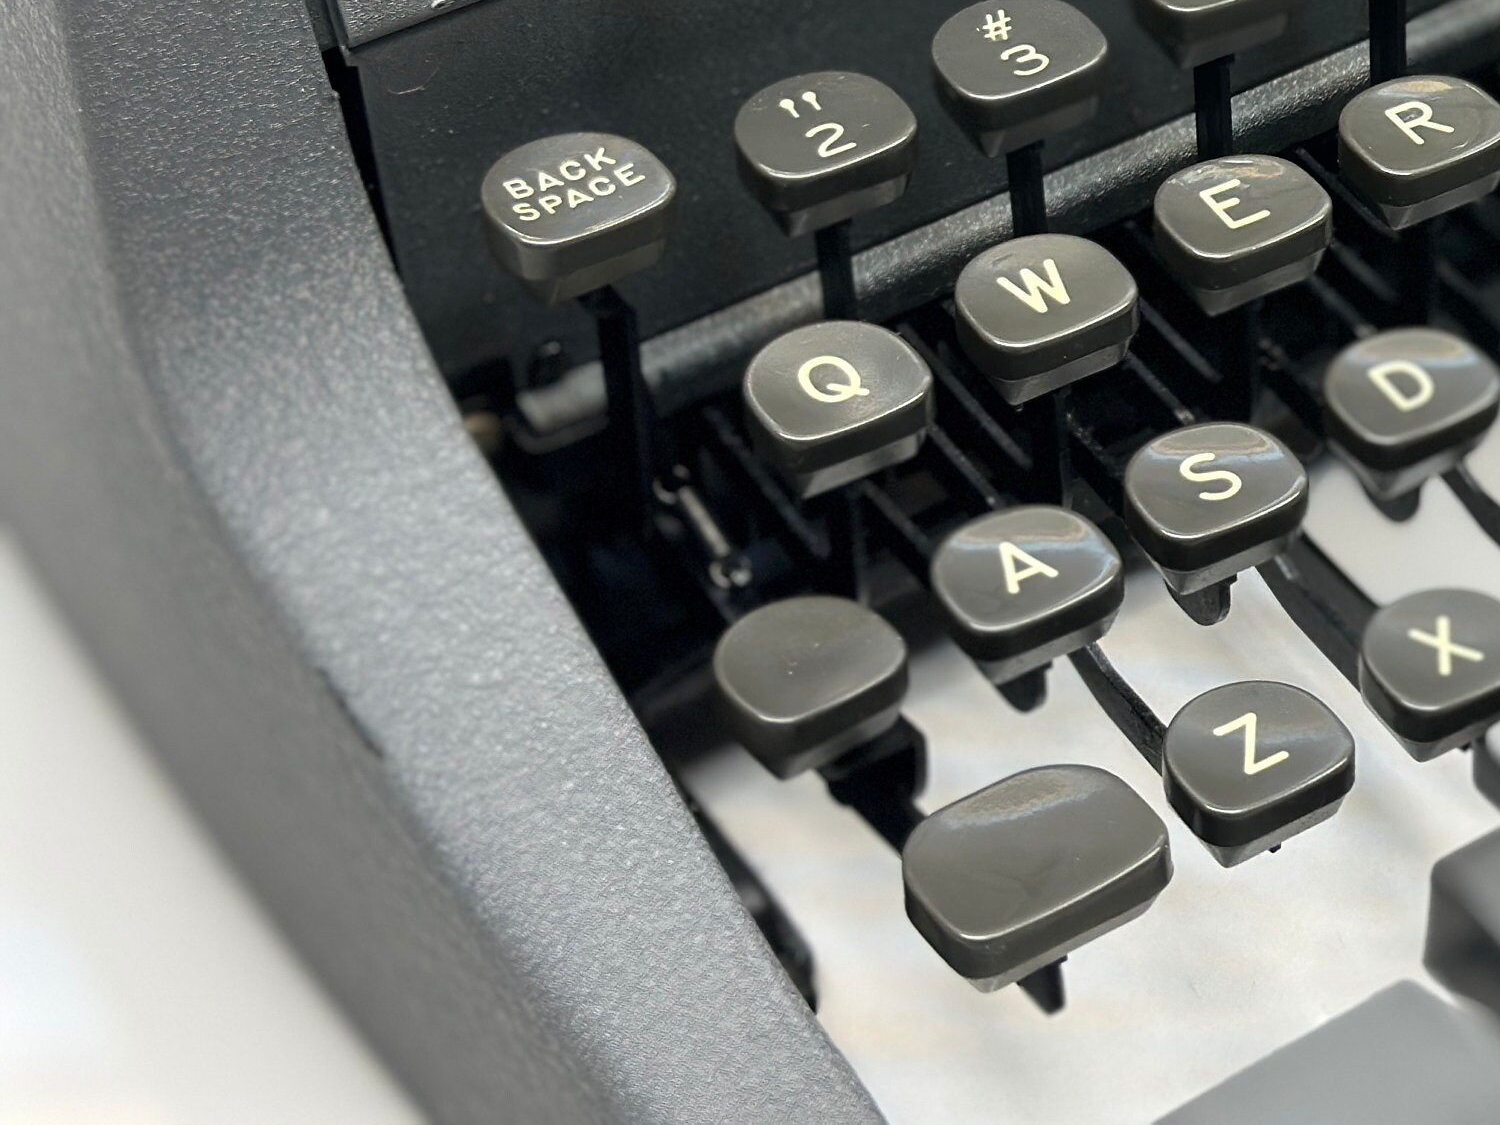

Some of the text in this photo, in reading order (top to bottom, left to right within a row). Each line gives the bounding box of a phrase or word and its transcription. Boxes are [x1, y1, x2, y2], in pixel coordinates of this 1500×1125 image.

[982, 9, 1013, 42] #
[1000, 43, 1051, 77] 3
[804, 121, 857, 159] 2
[1383, 99, 1456, 146] R
[502, 146, 618, 201] BACK
[511, 162, 646, 223] SPACE
[1199, 177, 1271, 230] E
[995, 257, 1072, 315] W
[796, 354, 872, 404] Q
[1367, 360, 1435, 411] D
[1178, 451, 1243, 502] S
[998, 540, 1060, 595] A
[1407, 614, 1485, 677] X
[1211, 711, 1291, 776] Z
